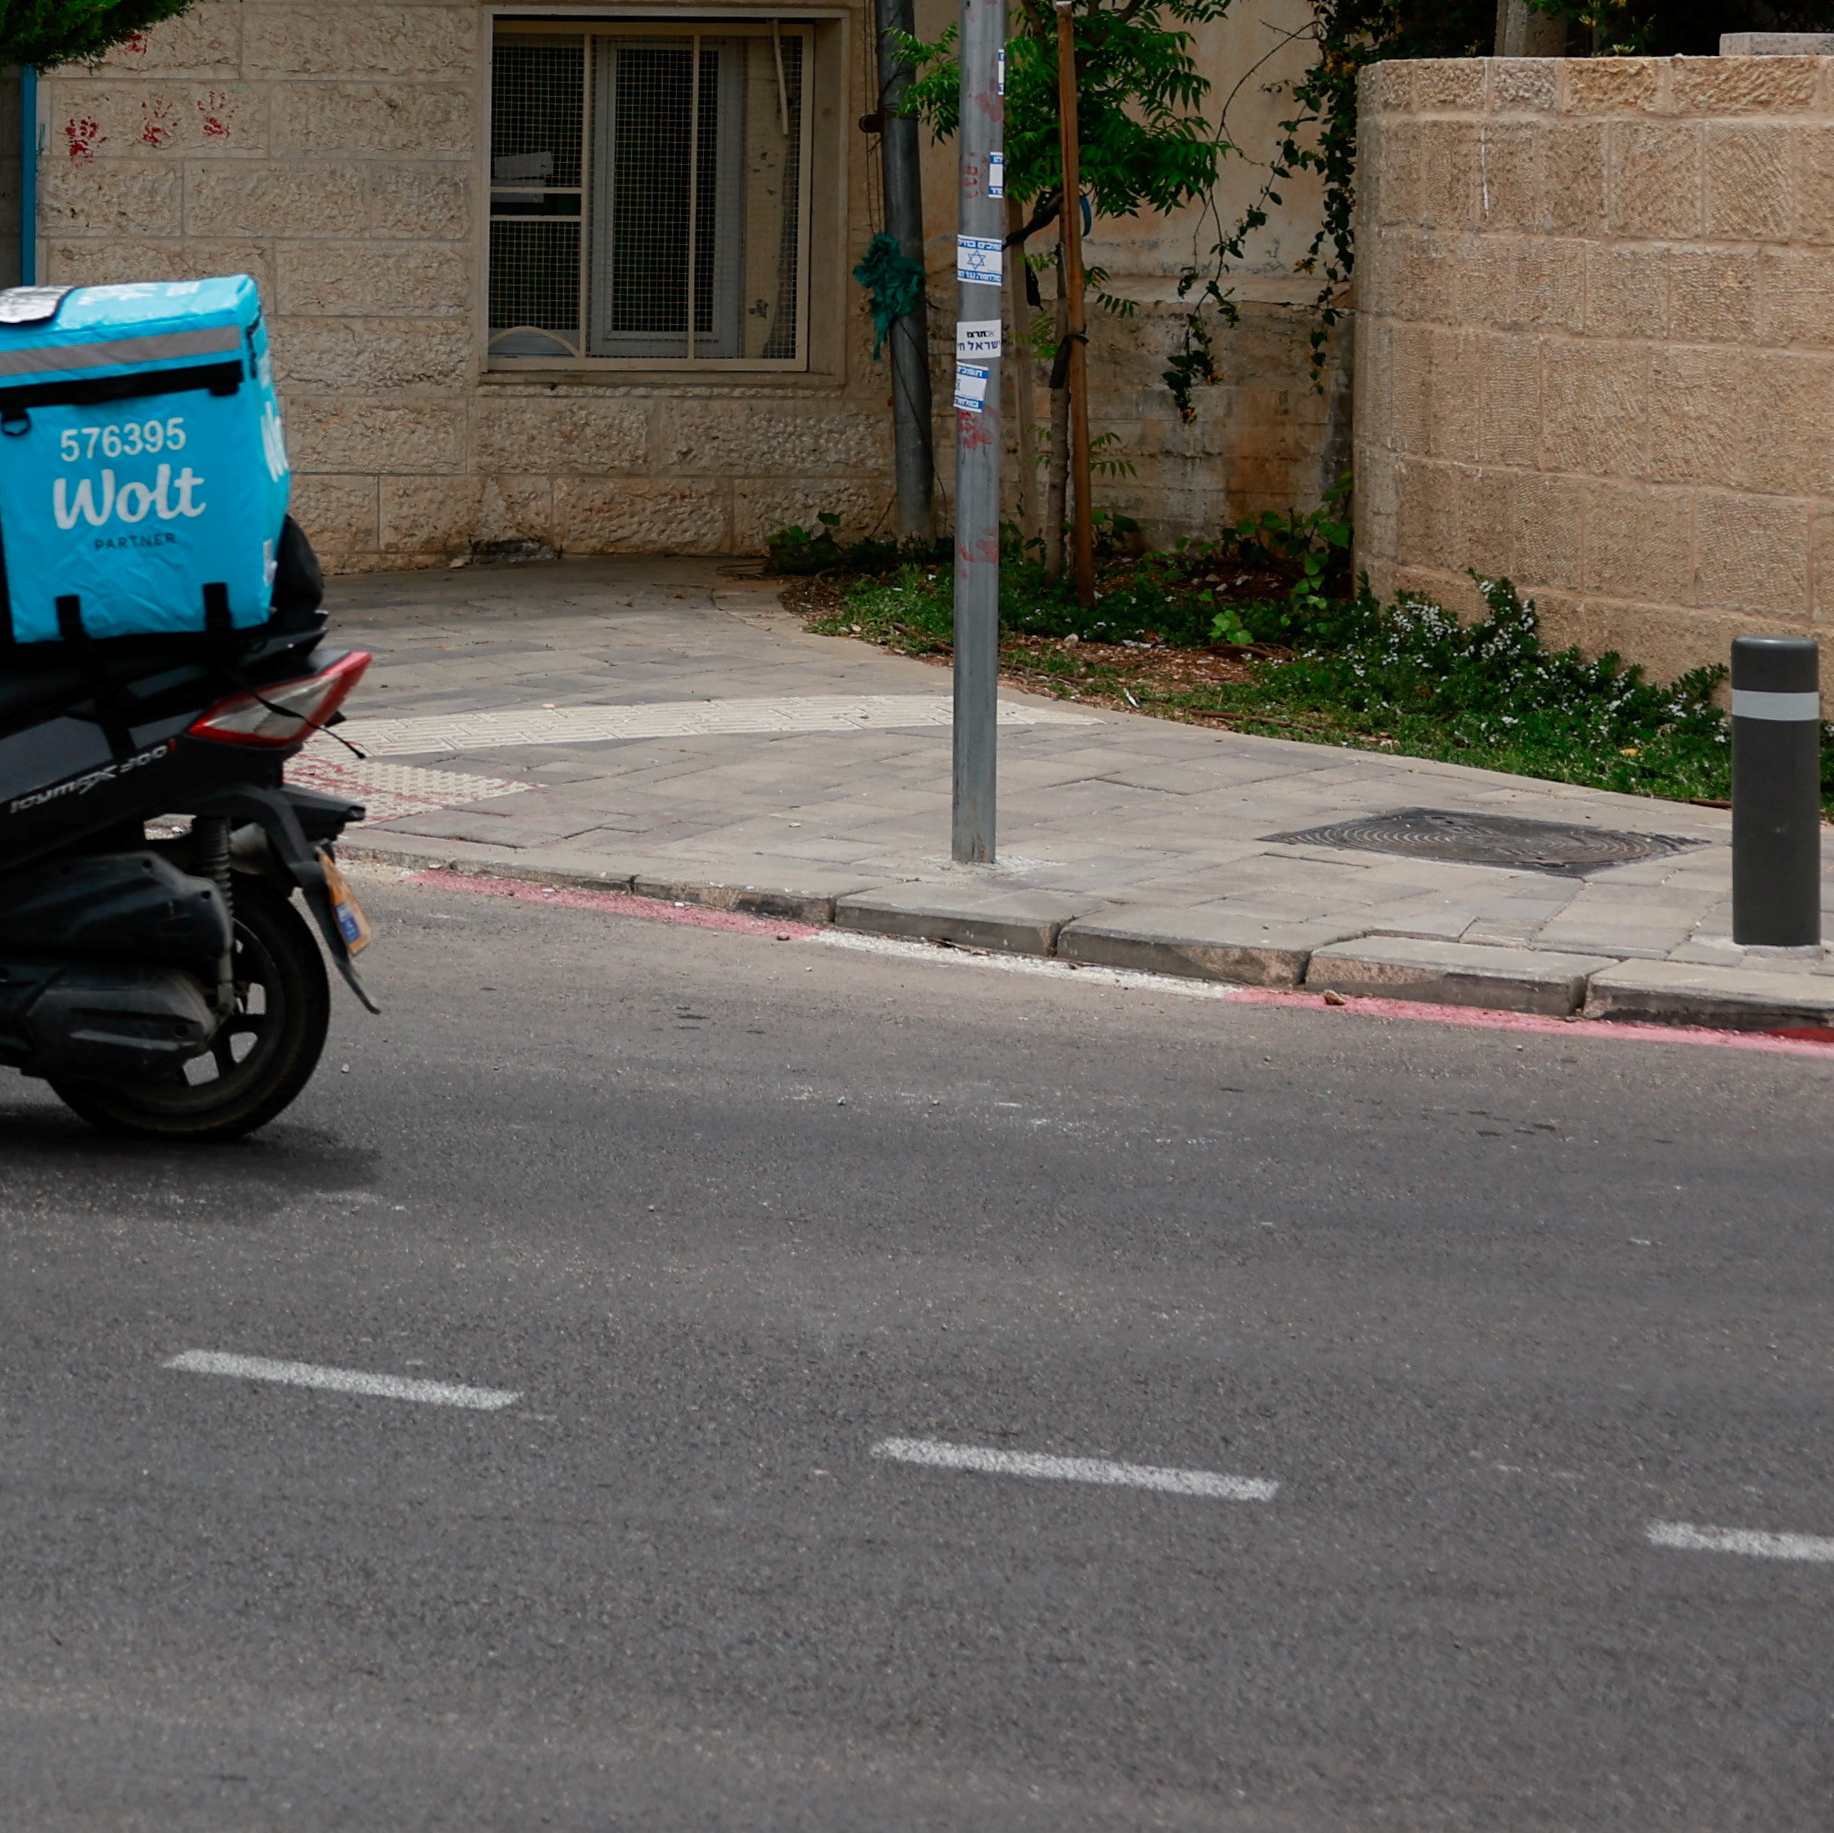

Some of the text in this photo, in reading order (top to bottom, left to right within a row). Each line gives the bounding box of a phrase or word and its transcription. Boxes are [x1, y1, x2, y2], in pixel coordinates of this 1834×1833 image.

[60, 417, 186, 462] 576395
[53, 463, 206, 530] Wolt
[94, 532, 176, 551] PARTNER
